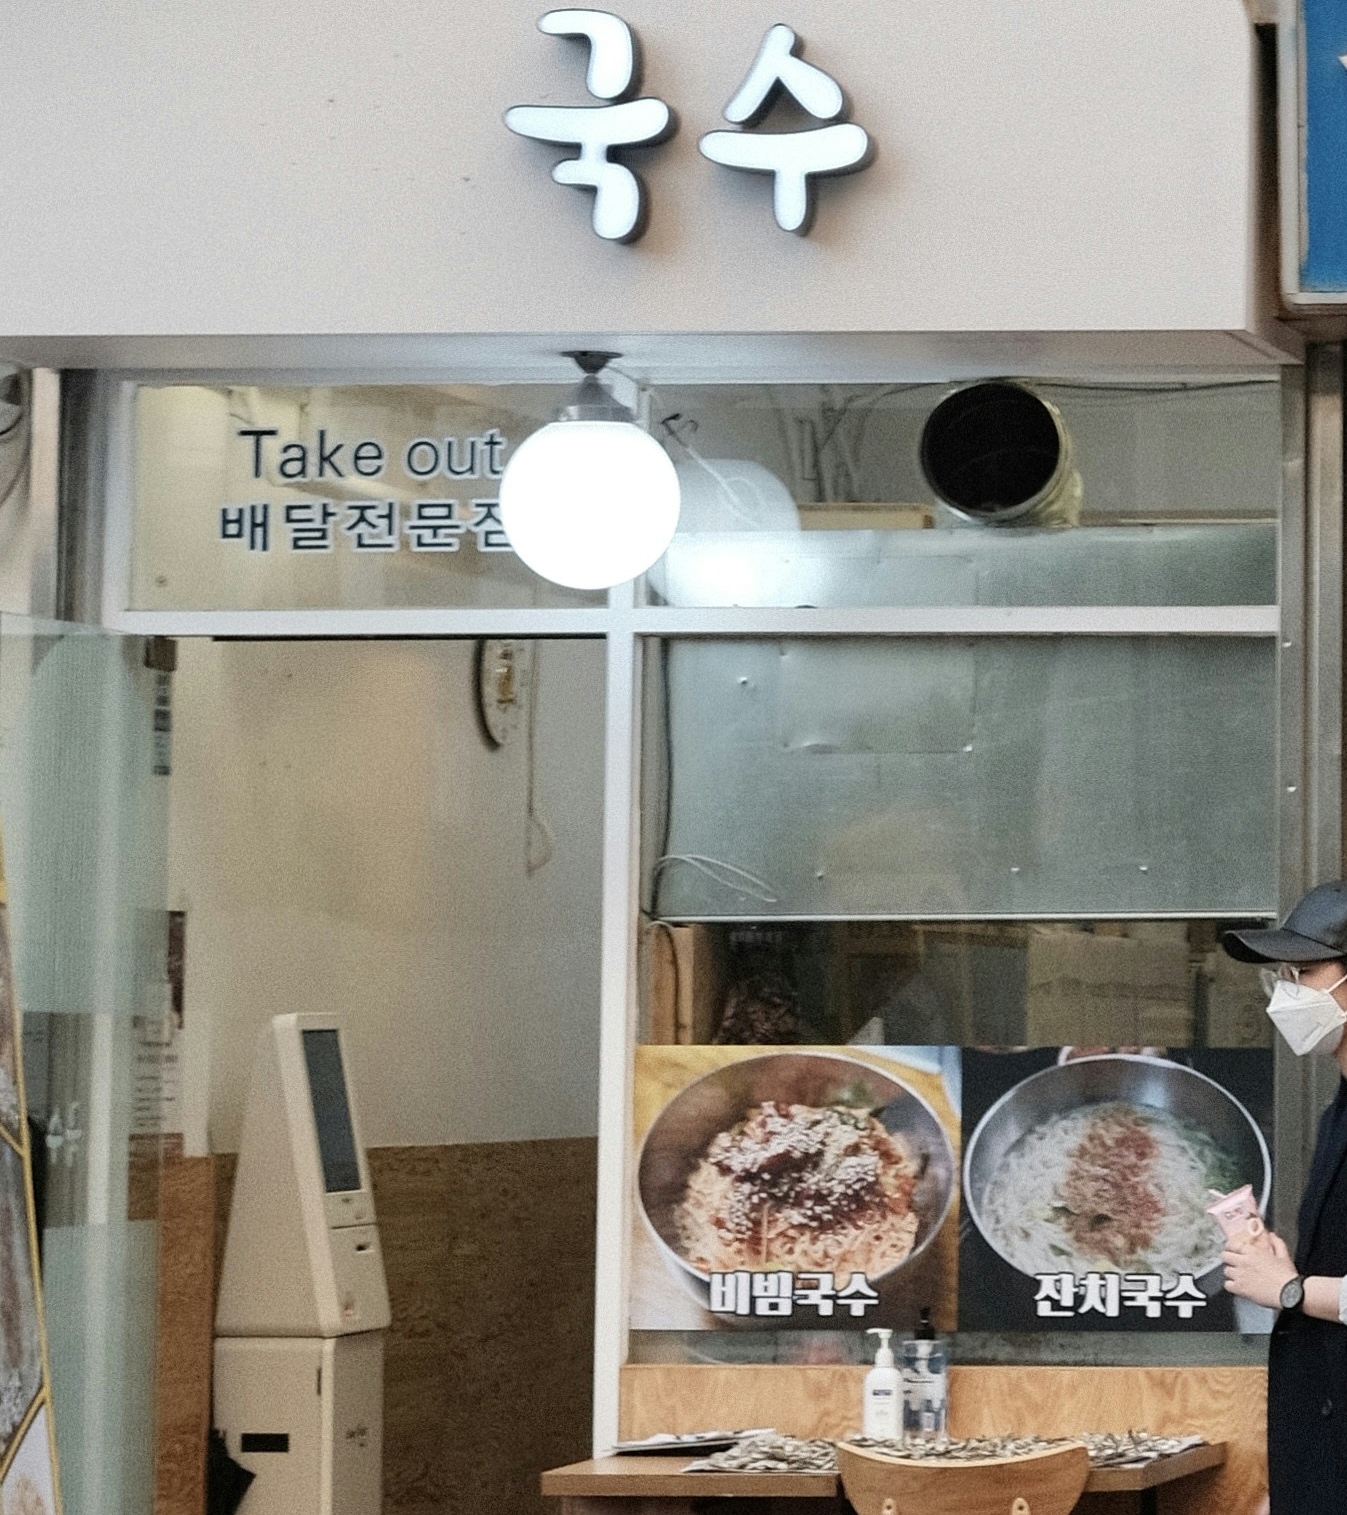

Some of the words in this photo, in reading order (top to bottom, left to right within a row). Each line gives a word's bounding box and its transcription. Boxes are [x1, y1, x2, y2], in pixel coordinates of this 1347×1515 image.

[504, 7, 874, 245] 국수
[237, 429, 385, 480] Take
[406, 433, 505, 478] out
[710, 1270, 880, 1317] 비빔국수
[1033, 1272, 1207, 1318] 잔치국수
